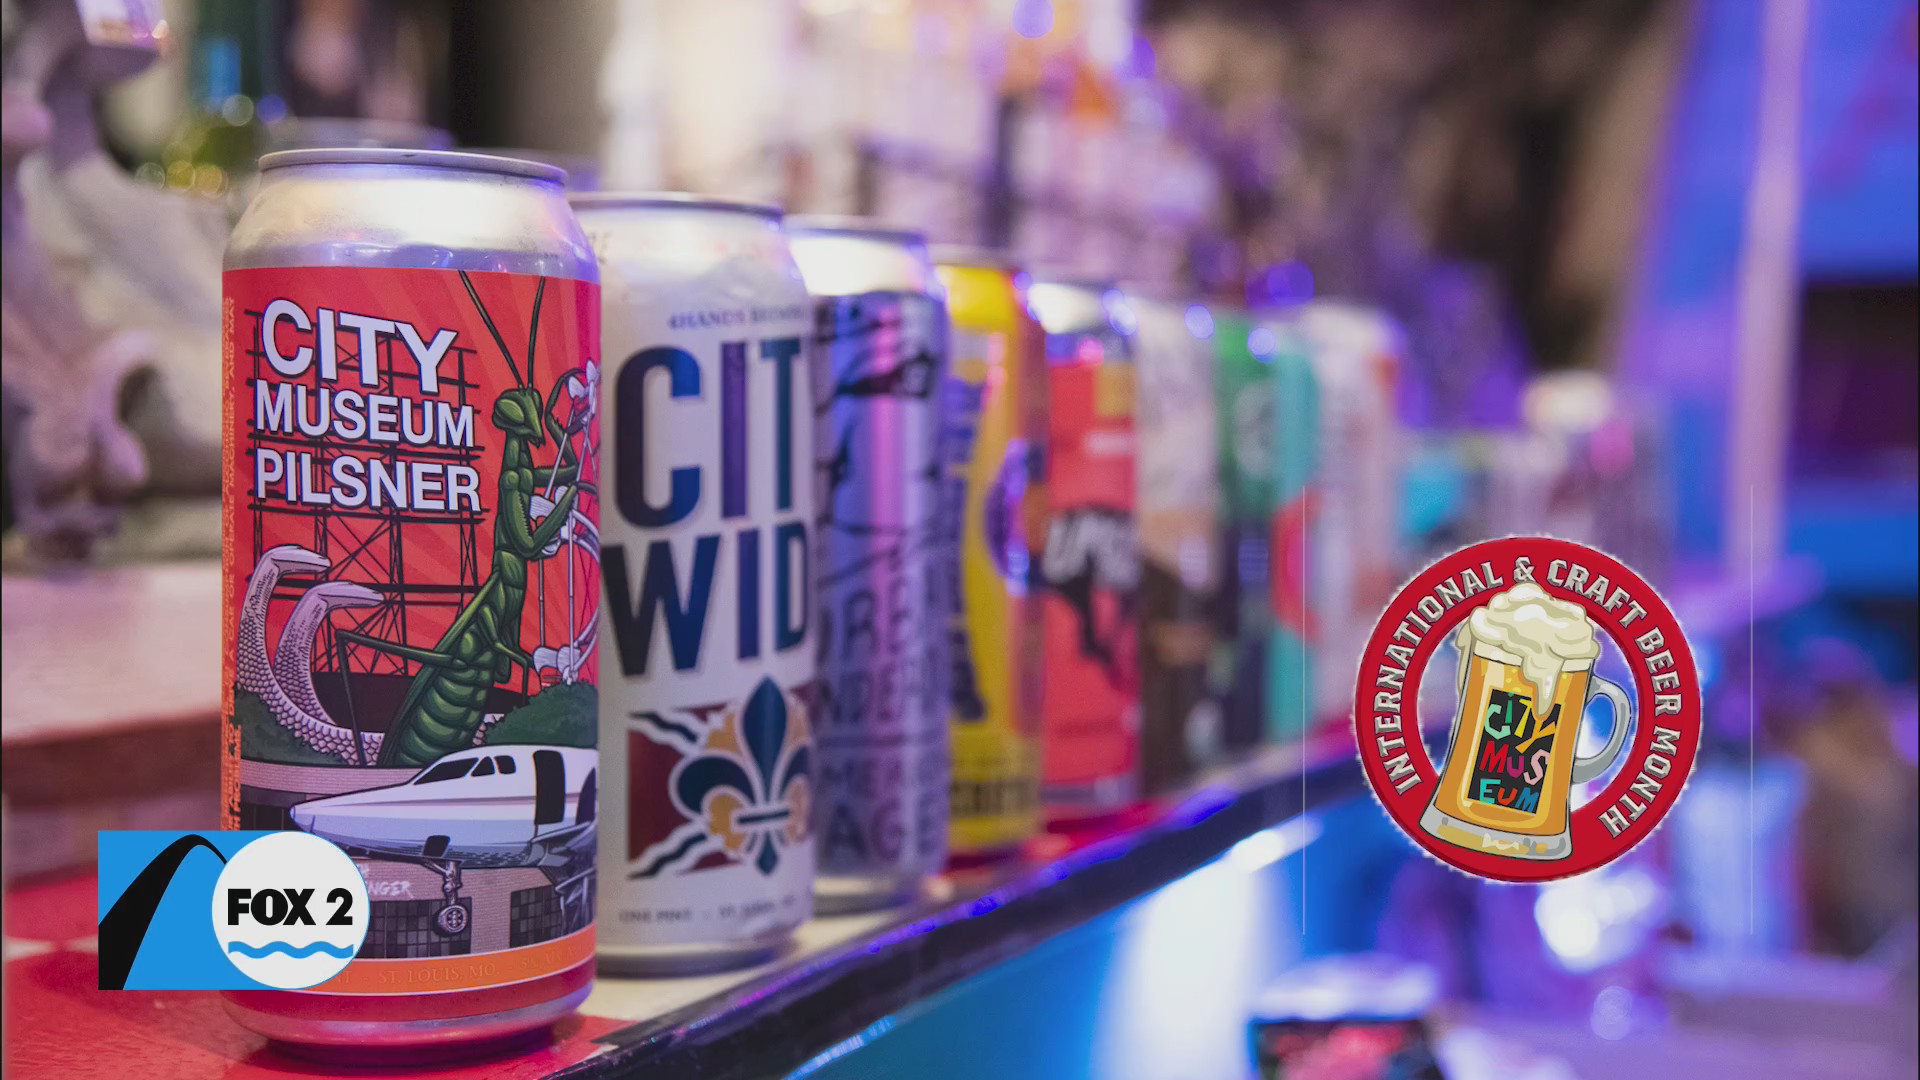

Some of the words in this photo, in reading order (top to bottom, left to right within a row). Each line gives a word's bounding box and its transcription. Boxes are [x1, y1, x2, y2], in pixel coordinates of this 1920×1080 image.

[261, 298, 459, 395] CITY
[255, 378, 475, 448] MUSEUM
[256, 448, 483, 512] PILSNER
[408, 967, 463, 983] LOUIS,
[469, 962, 500, 978] MO.
